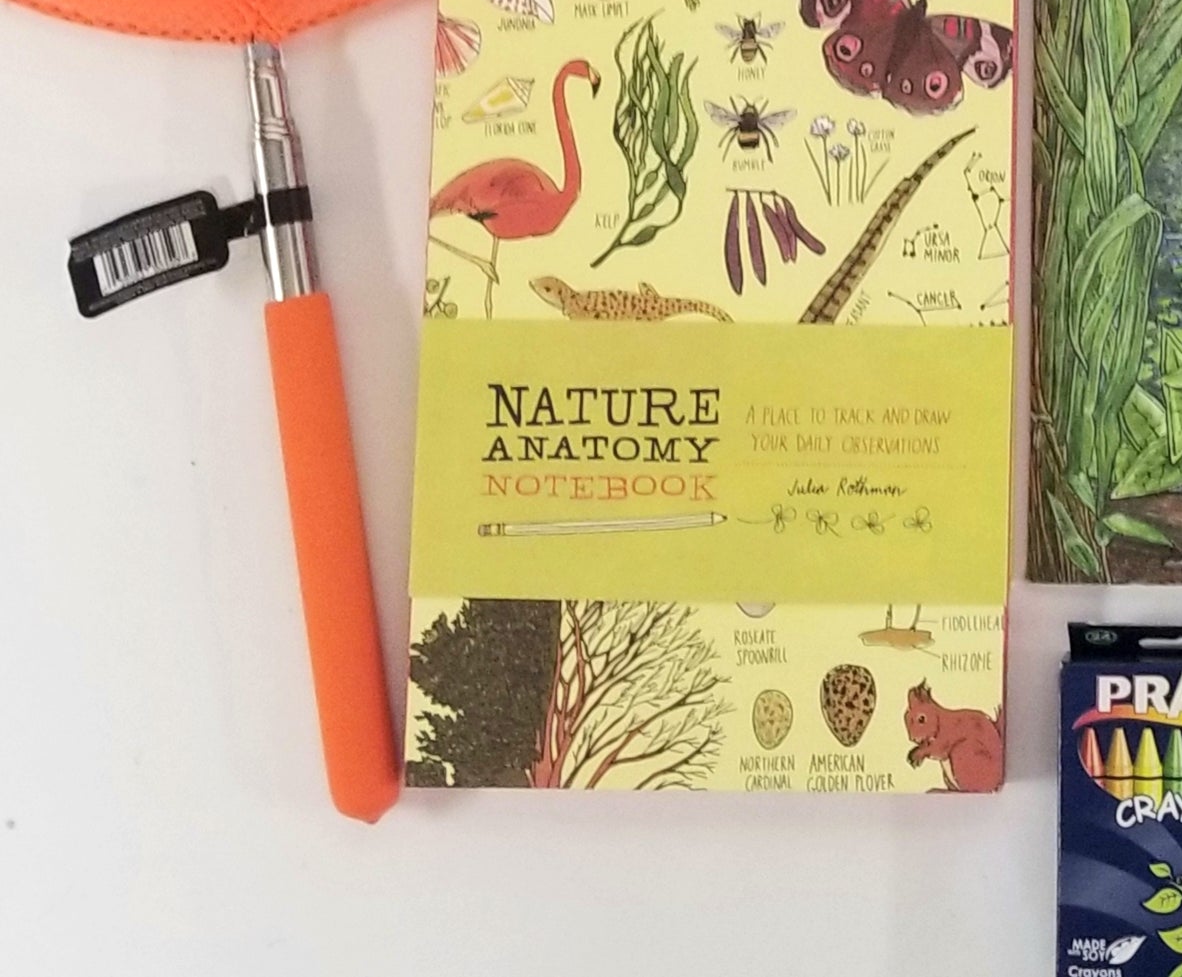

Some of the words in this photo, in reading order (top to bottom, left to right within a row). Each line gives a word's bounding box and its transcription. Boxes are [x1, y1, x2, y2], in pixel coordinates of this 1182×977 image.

[978, 170, 1006, 183] ORION
[924, 231, 951, 248] URSA
[923, 247, 960, 263] MINOR
[916, 289, 957, 307] CANCER
[485, 383, 721, 428] NATURE
[745, 405, 755, 425] A
[761, 406, 800, 425] PLACE
[810, 406, 826, 424] TO
[834, 406, 875, 424] TRACK
[882, 406, 910, 424] AND
[914, 407, 952, 424] DRAW
[481, 435, 720, 464] ANATOMY
[750, 433, 788, 452] YOUR
[796, 434, 832, 452] DAILY
[841, 435, 941, 456] OBSERVATIONS
[480, 474, 718, 501] NOTEBOOK
[787, 477, 830, 498] Julia
[836, 475, 907, 498] Rothman
[734, 629, 776, 646] ROSEATE
[736, 647, 788, 667] SPOONBILL
[941, 652, 993, 673] RHIZOME
[739, 754, 796, 774] NORTHERN
[809, 753, 866, 774] AMERICAN
[745, 774, 793, 793] CARDINAL
[806, 775, 849, 793] GOLDEN
[855, 773, 895, 793] PLOVER
[1072, 938, 1107, 952] MADE
[1082, 949, 1106, 962] SOY
